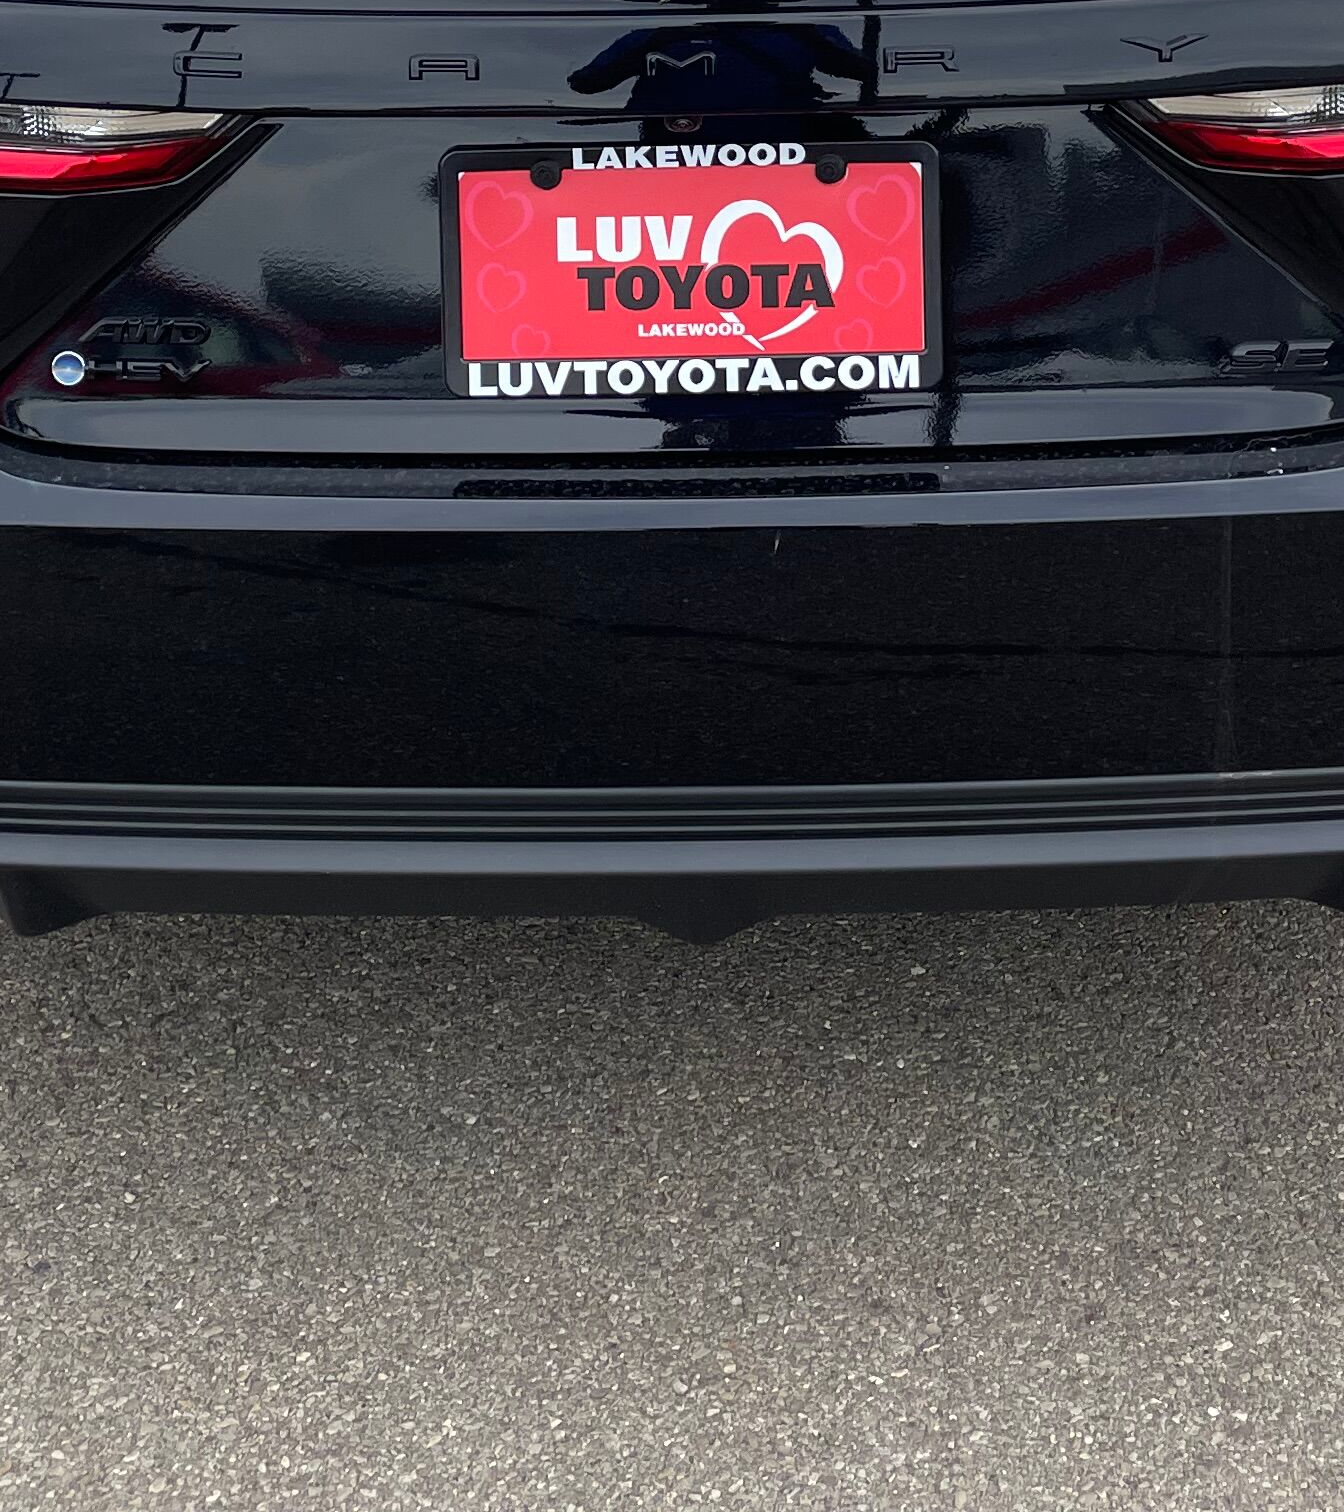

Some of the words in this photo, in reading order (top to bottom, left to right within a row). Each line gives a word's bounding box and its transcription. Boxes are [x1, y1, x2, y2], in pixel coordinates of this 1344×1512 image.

[173, 33, 1209, 81] CAMRY
[572, 143, 806, 169] LAKEWOOD
[556, 215, 693, 263] LUV
[577, 264, 835, 311] TOYOTA
[79, 317, 211, 344] AWD
[637, 322, 745, 337] LAKEWOOD
[87, 357, 212, 381] HEV
[1220, 340, 1334, 375] SE
[468, 354, 921, 397] LUVTOYOTA.COM
